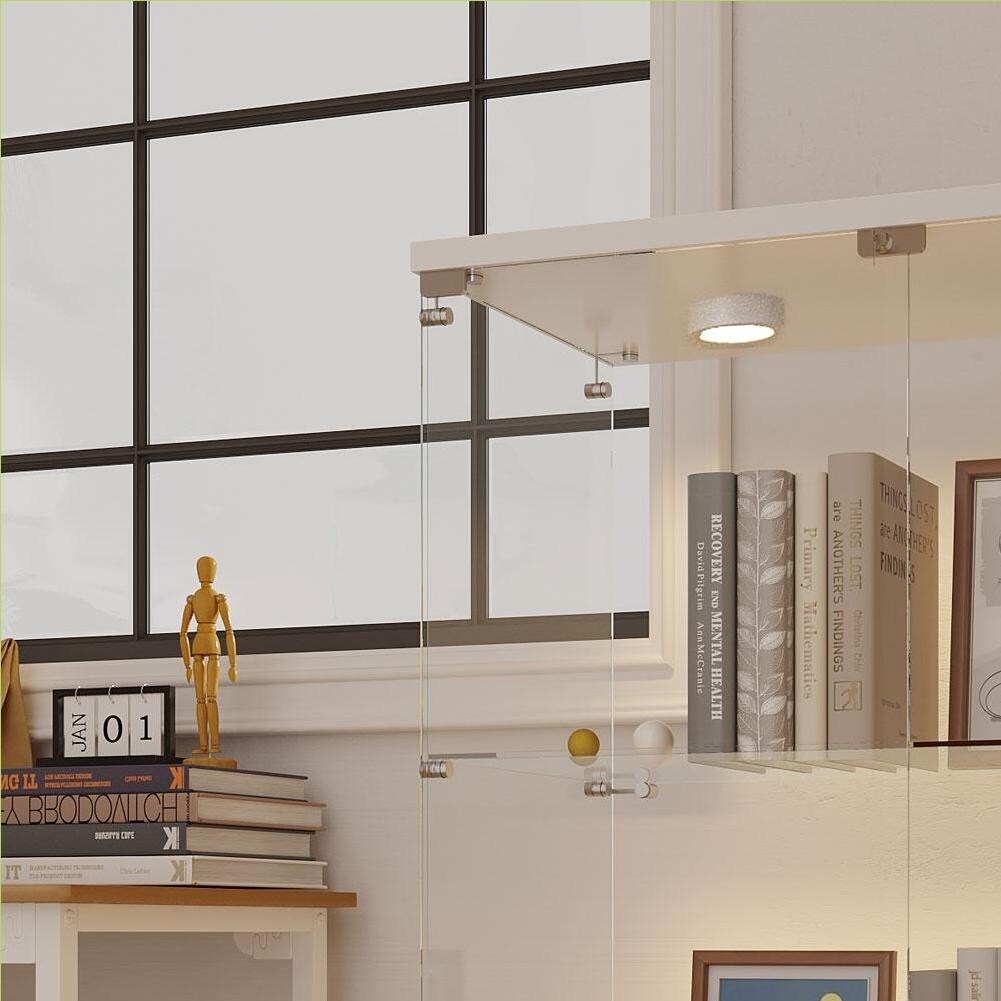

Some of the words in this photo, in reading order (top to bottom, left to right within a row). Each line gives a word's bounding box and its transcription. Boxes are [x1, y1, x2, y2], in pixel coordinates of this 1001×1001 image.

[833, 501, 842, 522] are
[849, 498, 863, 550] THINGS
[697, 542, 705, 572] David
[711, 513, 723, 584] RECOVERY
[800, 527, 817, 592] Primary
[832, 530, 844, 605] ANOTHER'S
[695, 574, 705, 611] Pilgrim
[696, 621, 705, 643] Ann
[711, 611, 723, 665] MENTAL
[803, 601, 818, 699] Mathematics
[833, 610, 844, 673] FINDINGS
[711, 668, 723, 720] HEALTH
[71, 713, 87, 752] JAN
[5, 865, 22, 881] IT
